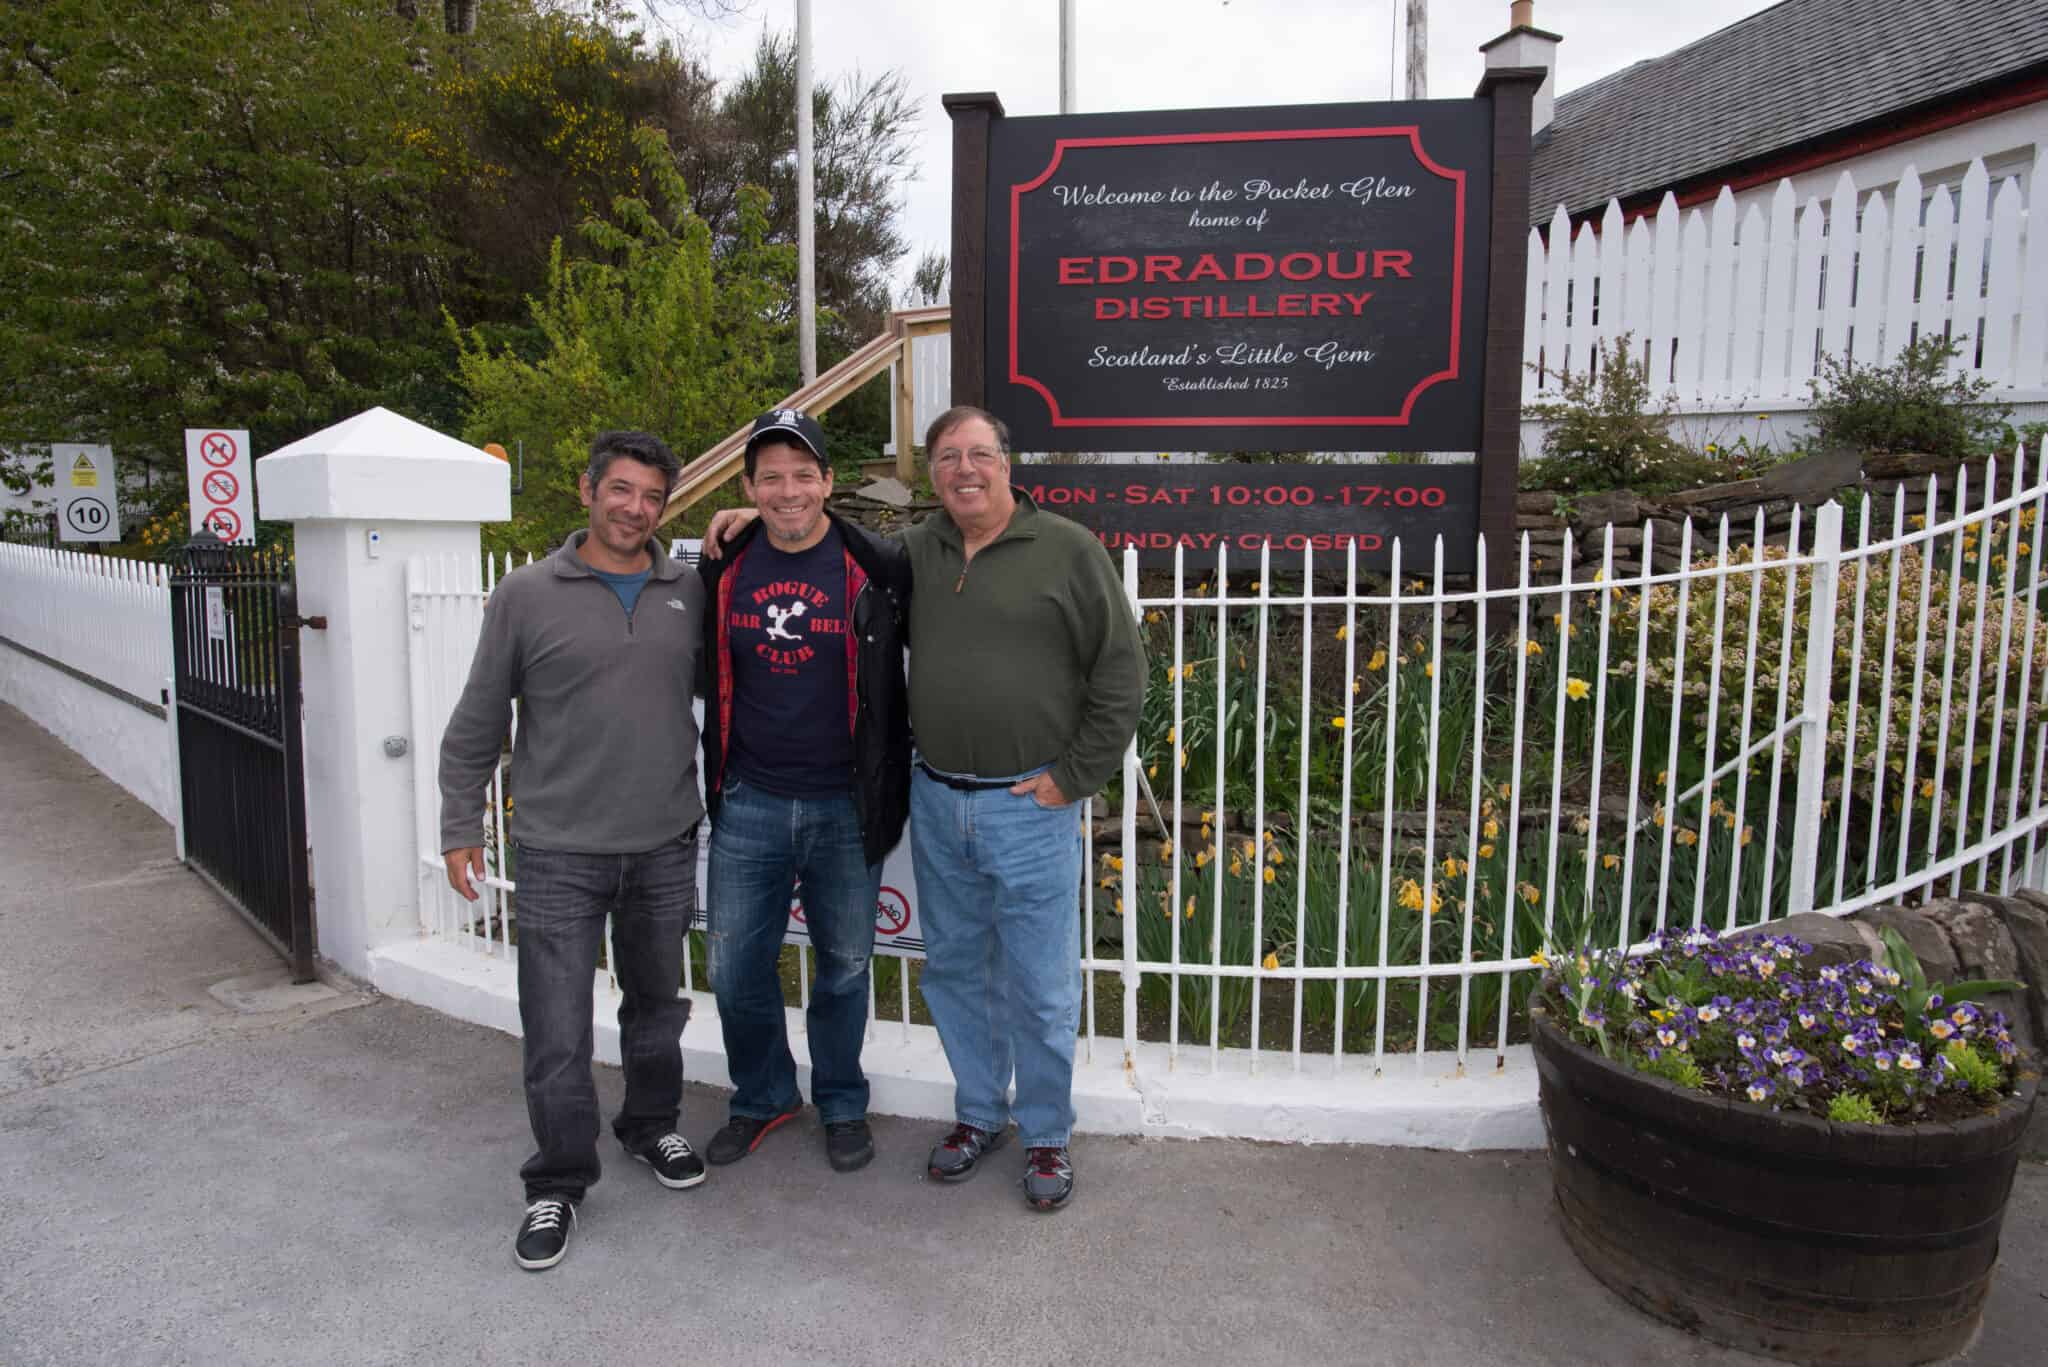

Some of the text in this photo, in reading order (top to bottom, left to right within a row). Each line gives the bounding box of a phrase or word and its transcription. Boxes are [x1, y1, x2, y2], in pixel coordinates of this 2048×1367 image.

[1052, 175, 1417, 206] Welcome to the Pocket Glen
[1188, 207, 1270, 232] home of
[1058, 250, 1414, 285] EDRADOUR
[1095, 293, 1373, 320] DISTILLERY
[1087, 341, 1376, 370] Scotland's Little Gem
[1162, 376, 1289, 391] Established 1825
[1124, 485, 1196, 505] SAT
[1210, 485, 1315, 506] 10:00
[75, 507, 102, 524] 10
[1092, 530, 1384, 551] UNDAY: CLOSED
[752, 581, 829, 608] ROGUE
[731, 612, 761, 629] BAR
[756, 644, 815, 665] CLUB
